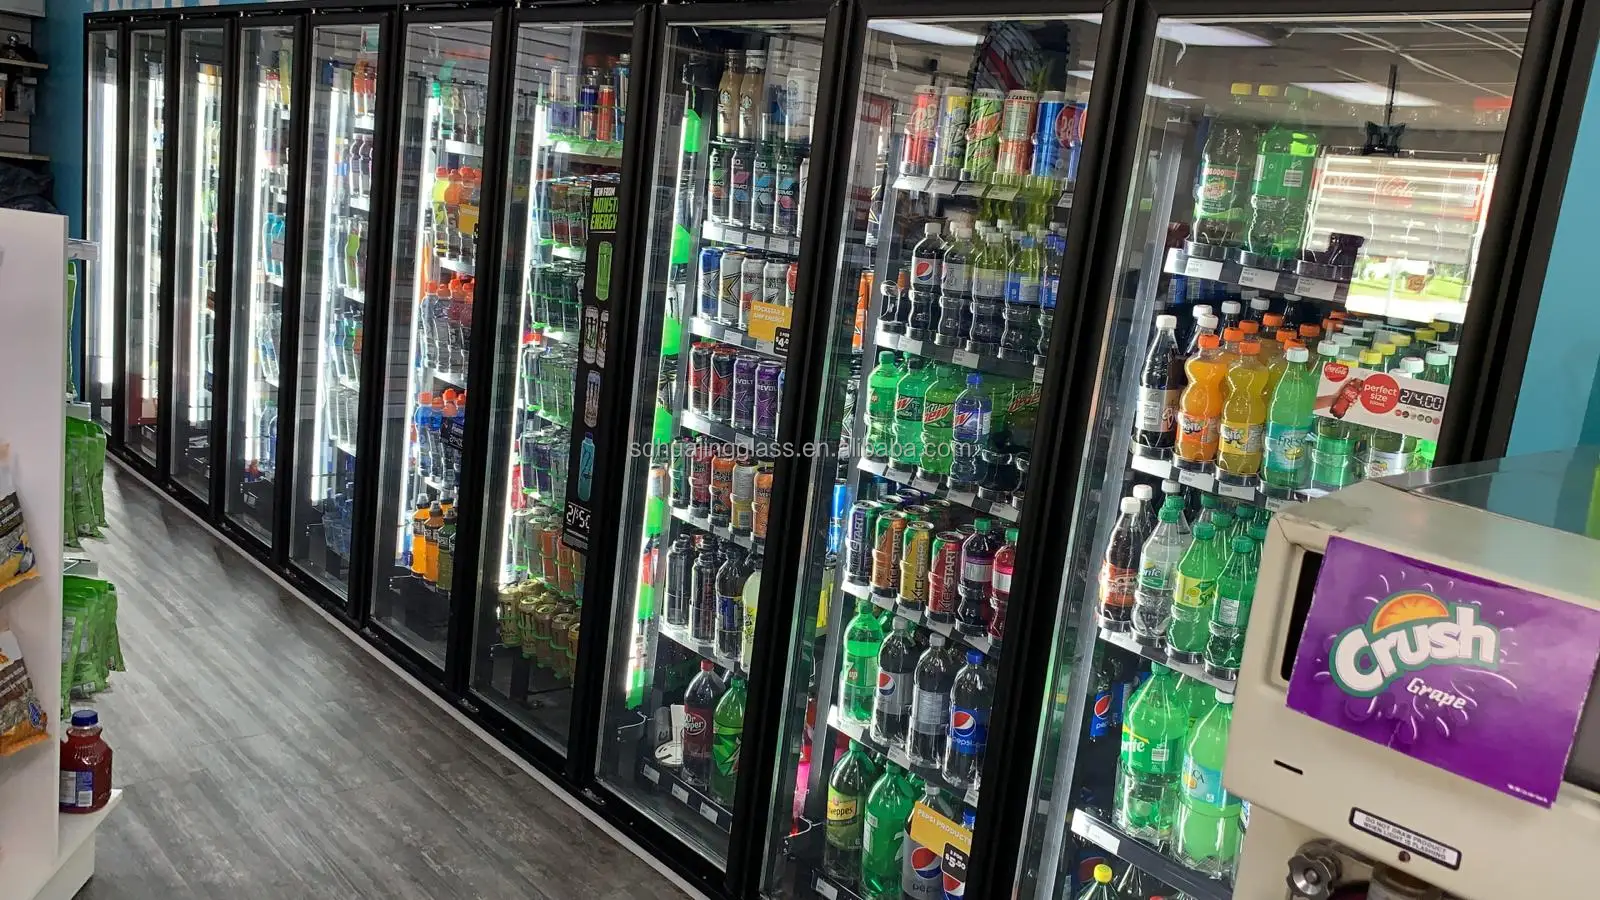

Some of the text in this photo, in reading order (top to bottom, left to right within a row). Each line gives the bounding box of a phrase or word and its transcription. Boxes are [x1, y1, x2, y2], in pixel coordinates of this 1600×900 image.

[590, 213, 618, 230] ENERGY
[592, 197, 619, 214] MONST
[1364, 383, 1397, 397] perfect
[1370, 393, 1388, 403] size
[939, 549, 956, 613] KICKSTART
[1334, 605, 1497, 692] Crush
[1406, 677, 1467, 710] Grape
[1363, 821, 1383, 834] WHEN
[1383, 830, 1404, 842] LIGHT
[1411, 842, 1446, 861] FLASHING
[1365, 816, 1447, 853] DO NOT DRAW PRODUCT
